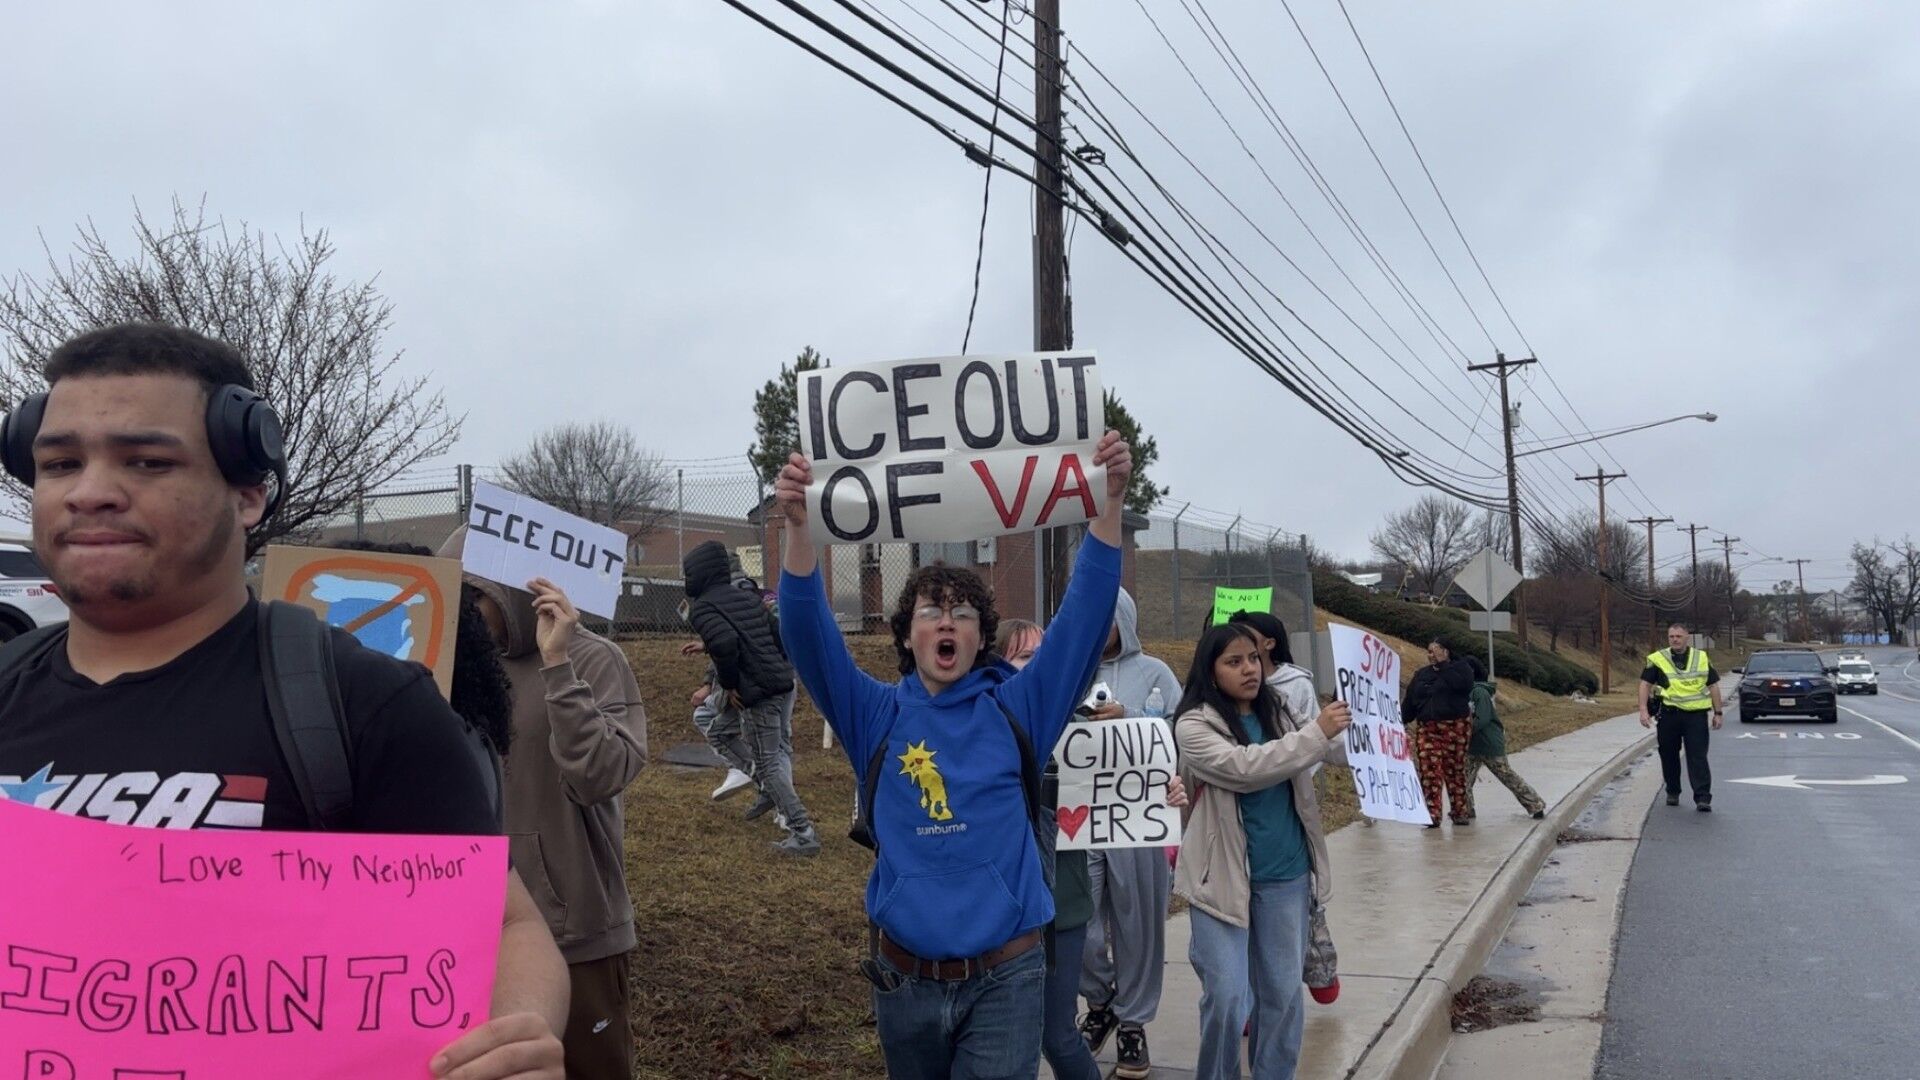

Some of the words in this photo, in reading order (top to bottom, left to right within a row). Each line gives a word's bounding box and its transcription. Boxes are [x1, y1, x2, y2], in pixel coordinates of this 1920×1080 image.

[807, 363, 947, 460] ICE
[955, 356, 1096, 450] OUT
[820, 461, 944, 541] OF
[970, 453, 1098, 528] VA
[469, 503, 544, 550] ICE
[551, 530, 624, 573] OUT
[1361, 634, 1392, 684] STOP
[1063, 723, 1171, 769] GINIA
[1093, 769, 1171, 804] FOR
[272, 849, 333, 890] Thy
